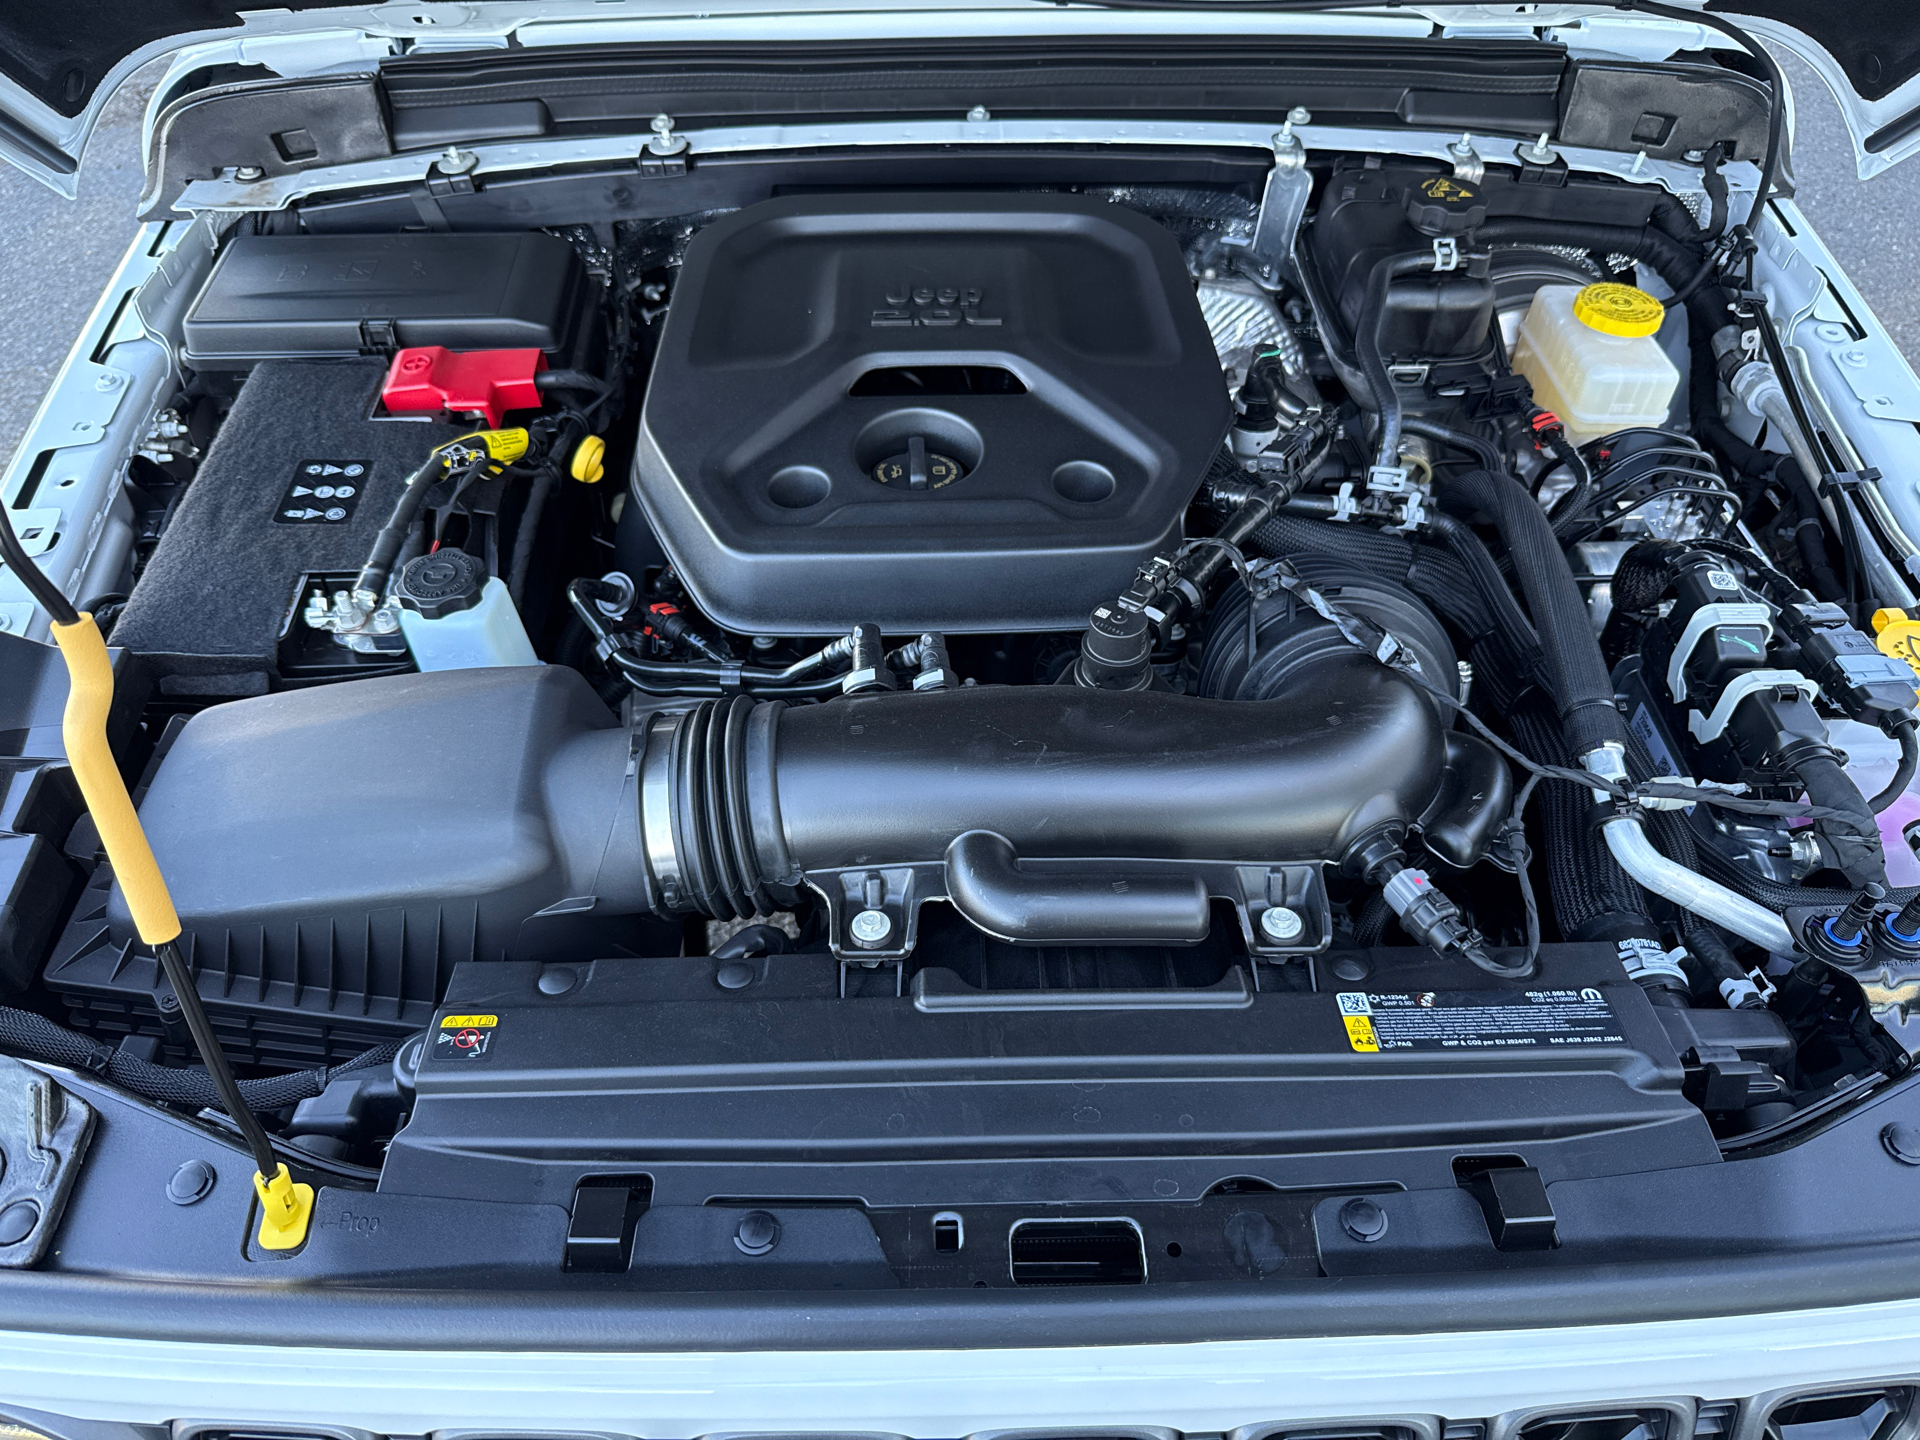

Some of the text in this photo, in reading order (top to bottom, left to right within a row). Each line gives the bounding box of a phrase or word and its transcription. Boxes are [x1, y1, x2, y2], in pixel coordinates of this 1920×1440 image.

[886, 284, 983, 308] Jeep
[871, 309, 1003, 327] 2.0L
[1618, 938, 1662, 950] 6820781AD
[338, 1210, 380, 1238] Prop
